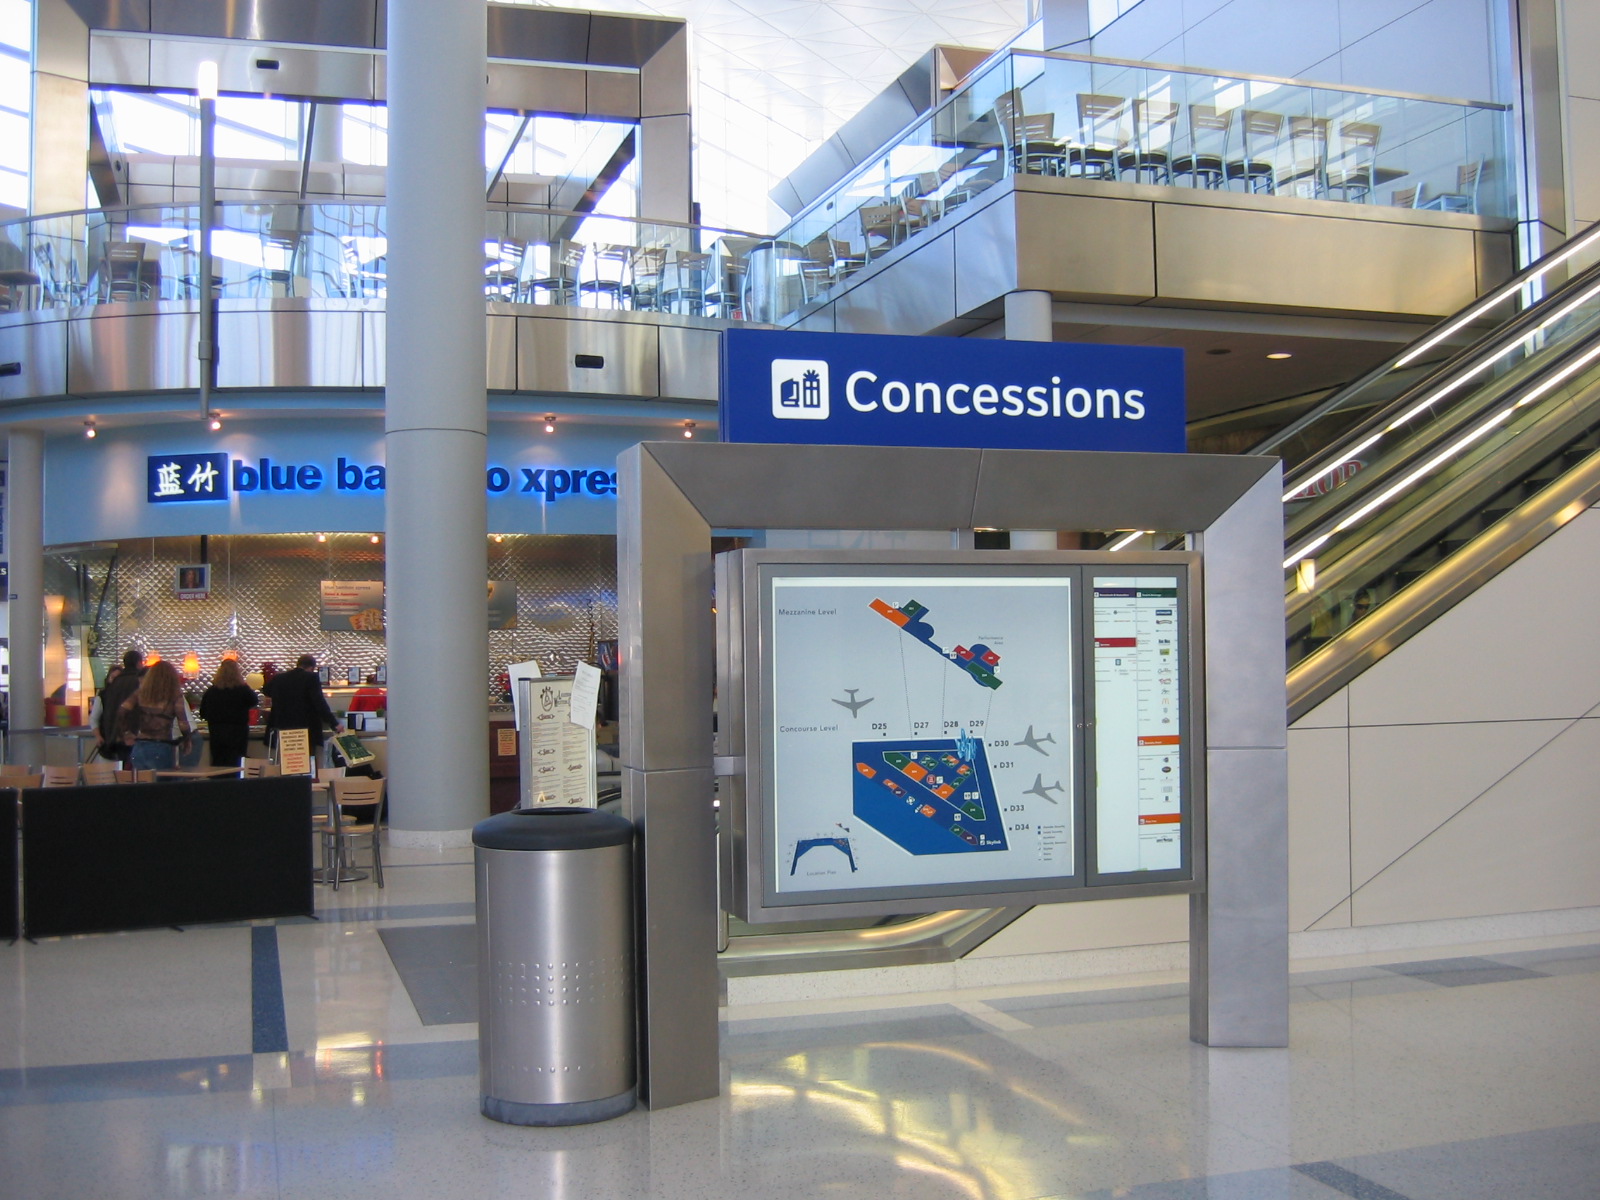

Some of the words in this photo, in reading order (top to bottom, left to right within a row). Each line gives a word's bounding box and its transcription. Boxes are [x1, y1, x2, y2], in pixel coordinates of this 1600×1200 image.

[845, 370, 1146, 420] Concessions
[232, 458, 323, 491] blue
[338, 457, 510, 493] bao
[778, 608, 816, 616] Mezzanine
[817, 608, 837, 616] Level
[779, 725, 818, 733] Concourse
[819, 723, 839, 732] Level
[914, 721, 929, 729] D27
[1010, 804, 1025, 812] D33
[1015, 823, 1030, 831] D34
